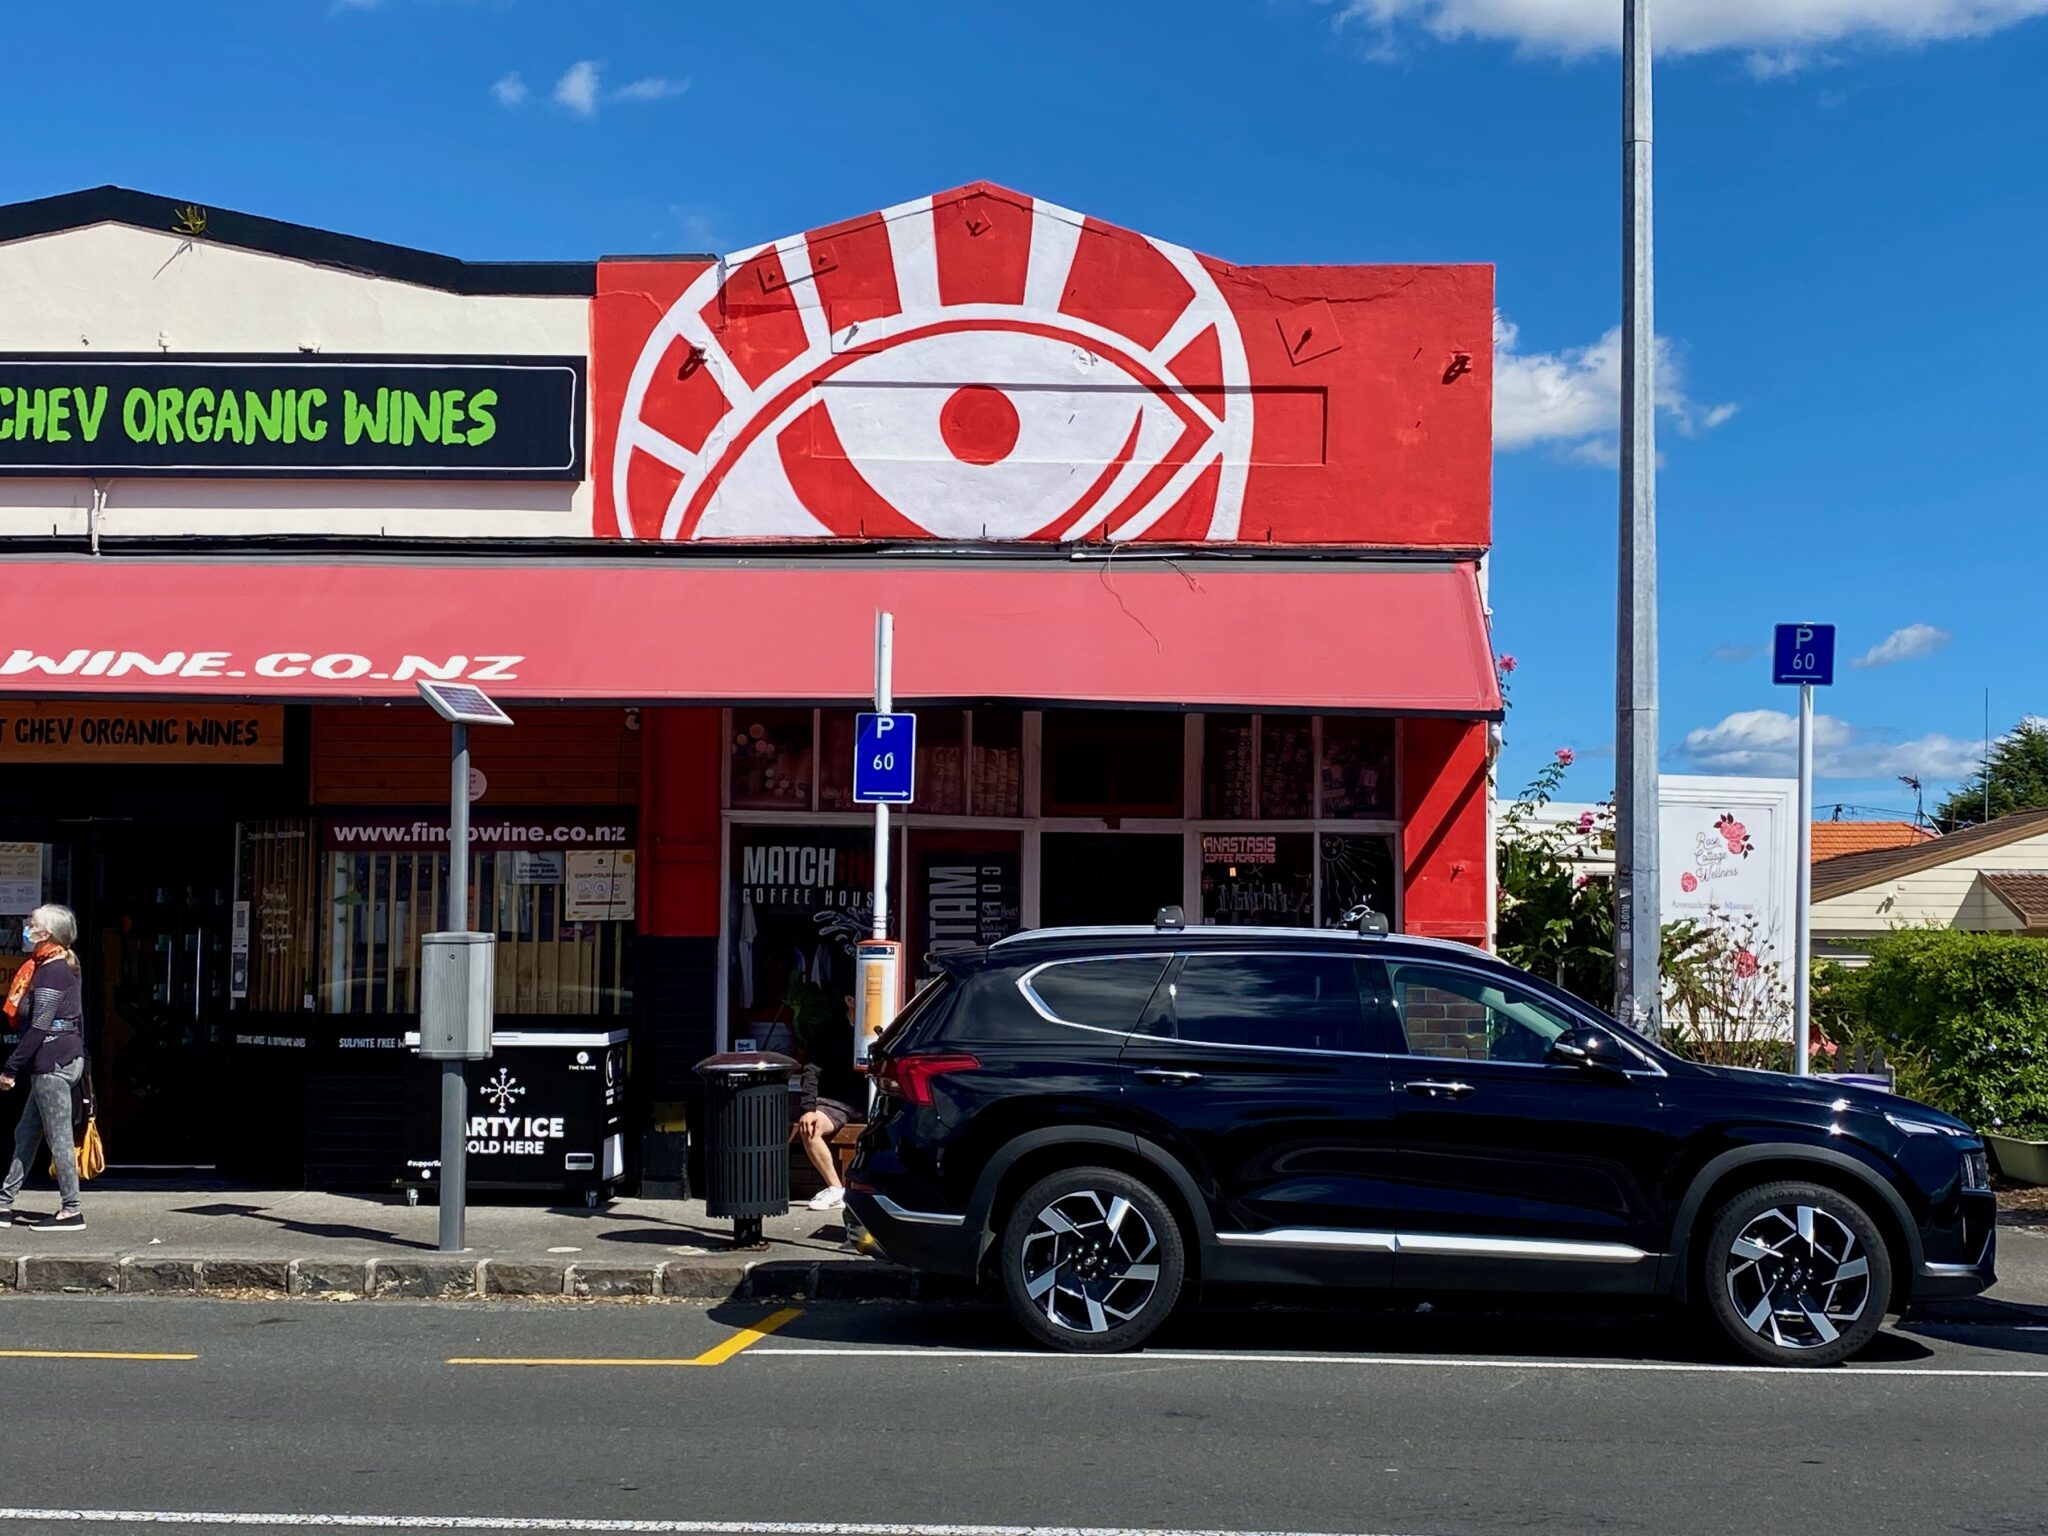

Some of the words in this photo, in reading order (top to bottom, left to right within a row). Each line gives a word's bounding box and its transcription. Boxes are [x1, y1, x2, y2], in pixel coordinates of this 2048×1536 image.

[123, 387, 328, 446] ORGANIC
[343, 387, 498, 447] WINES
[1795, 628, 1814, 650] P
[0, 649, 526, 681] WINE.CO.NZ
[1792, 653, 1815, 671] 60
[15, 718, 74, 745] CHEV
[80, 718, 179, 746] ORGANIC
[186, 718, 260, 747] WINES
[876, 716, 895, 739] P
[872, 752, 895, 771] 60
[1204, 836, 1277, 853] ANASTASIS
[1696, 832, 1723, 850] Rose
[743, 846, 836, 887] MATCH
[1204, 853, 1234, 864] COFFEE
[1235, 853, 1276, 864] ROASTERS
[1696, 865, 1738, 882] Wellness
[743, 887, 811, 905] COFFEE
[825, 890, 874, 907] HOUS
[338, 1037, 376, 1048] SULPHITE
[377, 1037, 396, 1048] FREE
[524, 1117, 565, 1139] ICE
[503, 1140, 545, 1155] HERE
